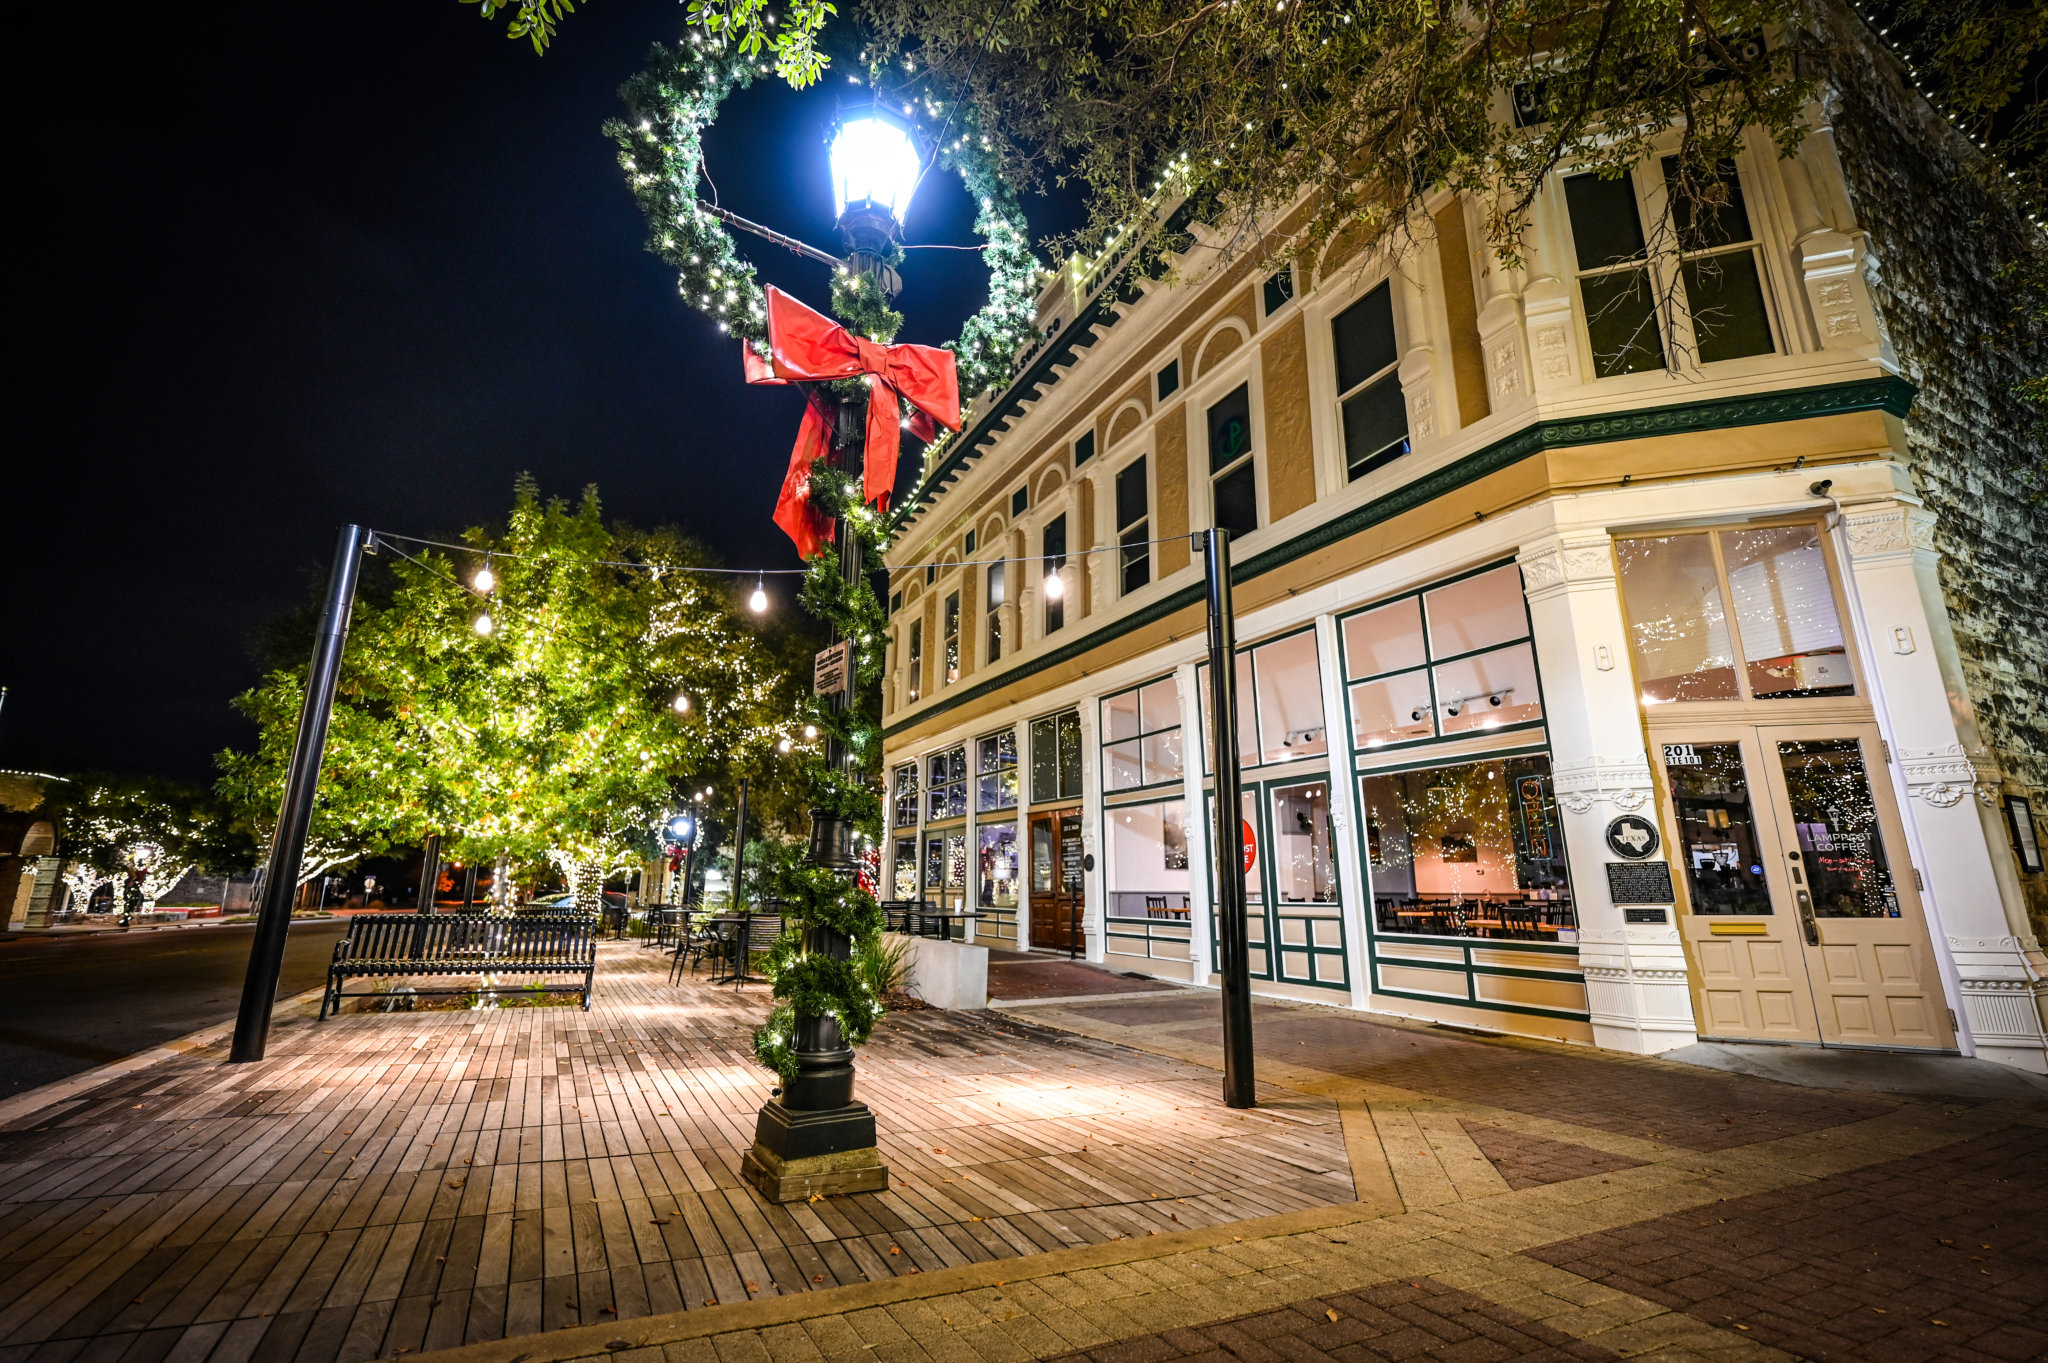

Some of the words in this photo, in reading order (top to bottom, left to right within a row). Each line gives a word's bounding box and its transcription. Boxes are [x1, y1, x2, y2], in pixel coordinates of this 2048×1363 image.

[1664, 745, 1692, 757] 201
[1521, 780, 1547, 857] OPEN
[1806, 833, 1872, 842] LAMPPOST
[1816, 842, 1865, 851] COFFEE
